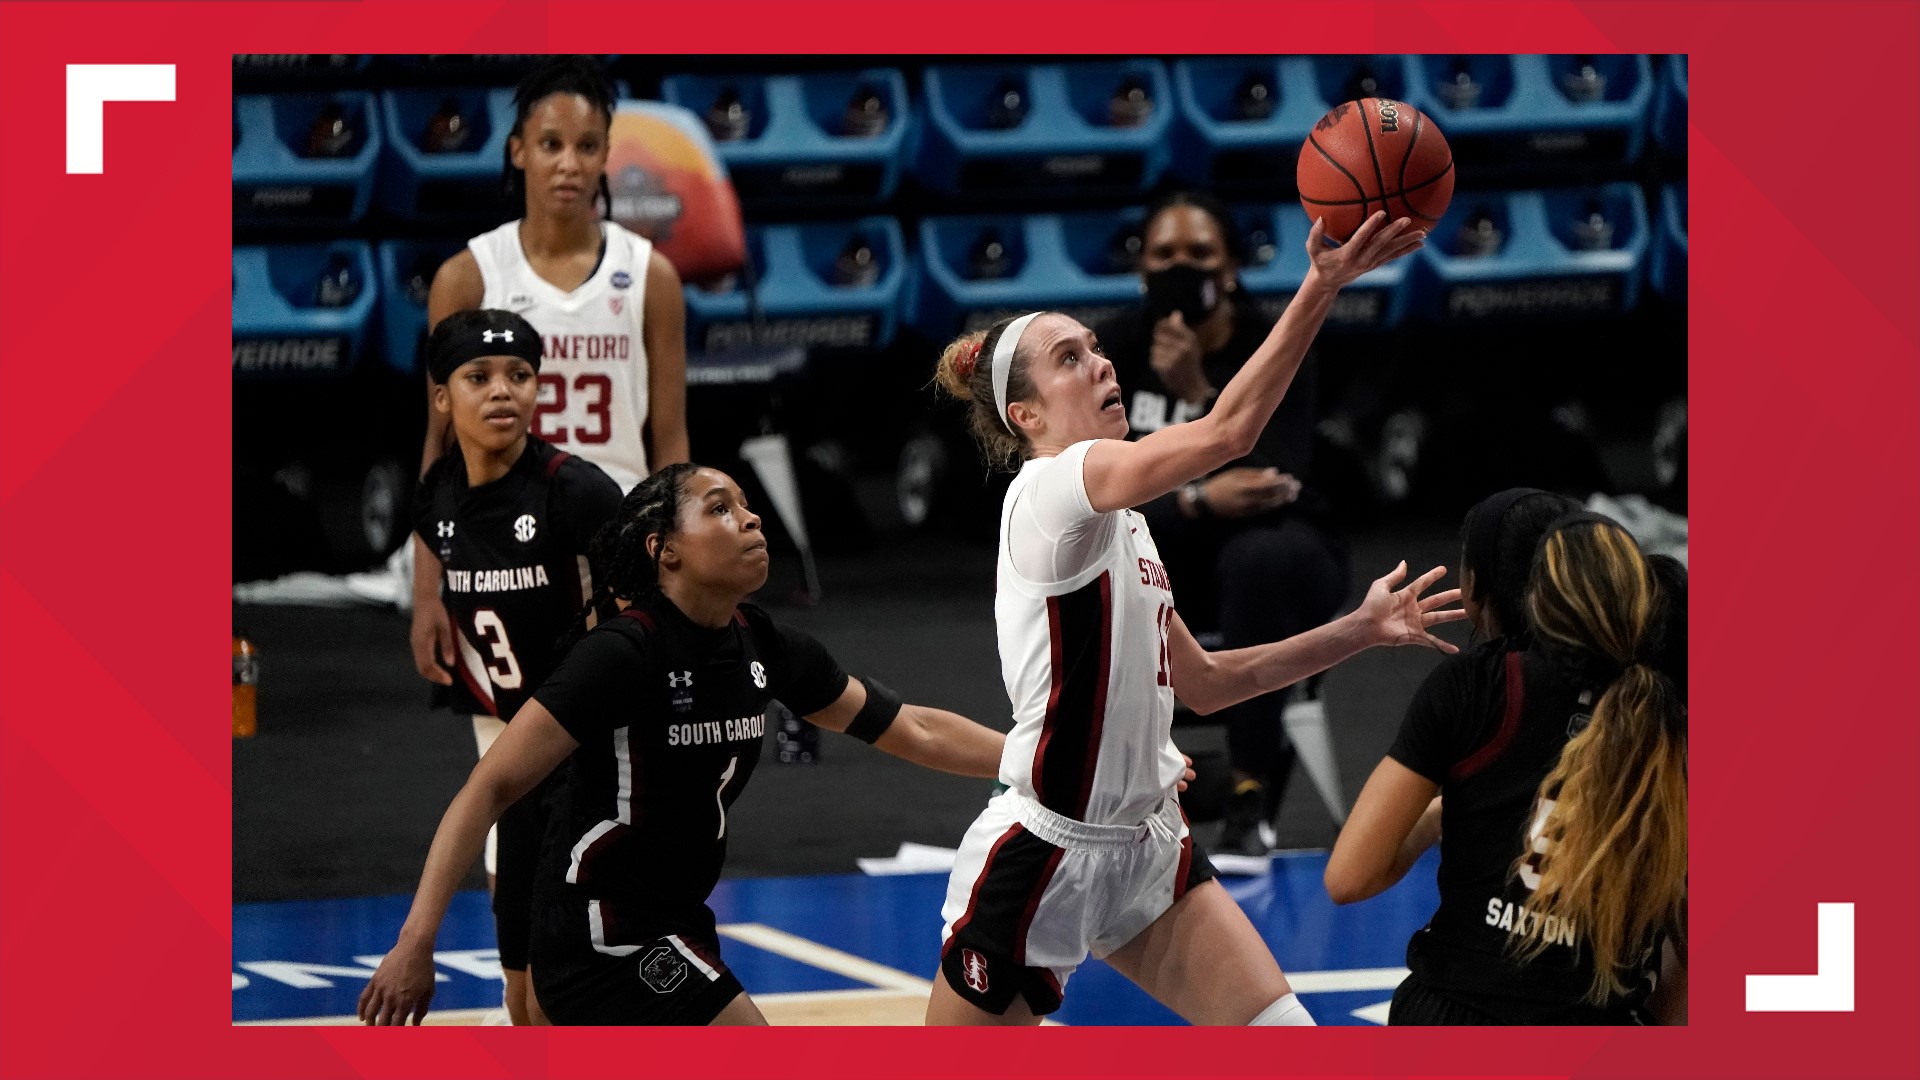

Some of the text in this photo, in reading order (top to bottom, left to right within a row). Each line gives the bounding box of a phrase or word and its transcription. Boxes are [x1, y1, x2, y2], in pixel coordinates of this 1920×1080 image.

[531, 373, 611, 444] 23
[514, 514, 536, 542] SEC
[474, 564, 549, 593] CAROLINA
[474, 610, 522, 689] 3
[668, 721, 721, 746] SOUTH
[716, 756, 738, 840] 1
[1485, 897, 1576, 948] SAXTON
